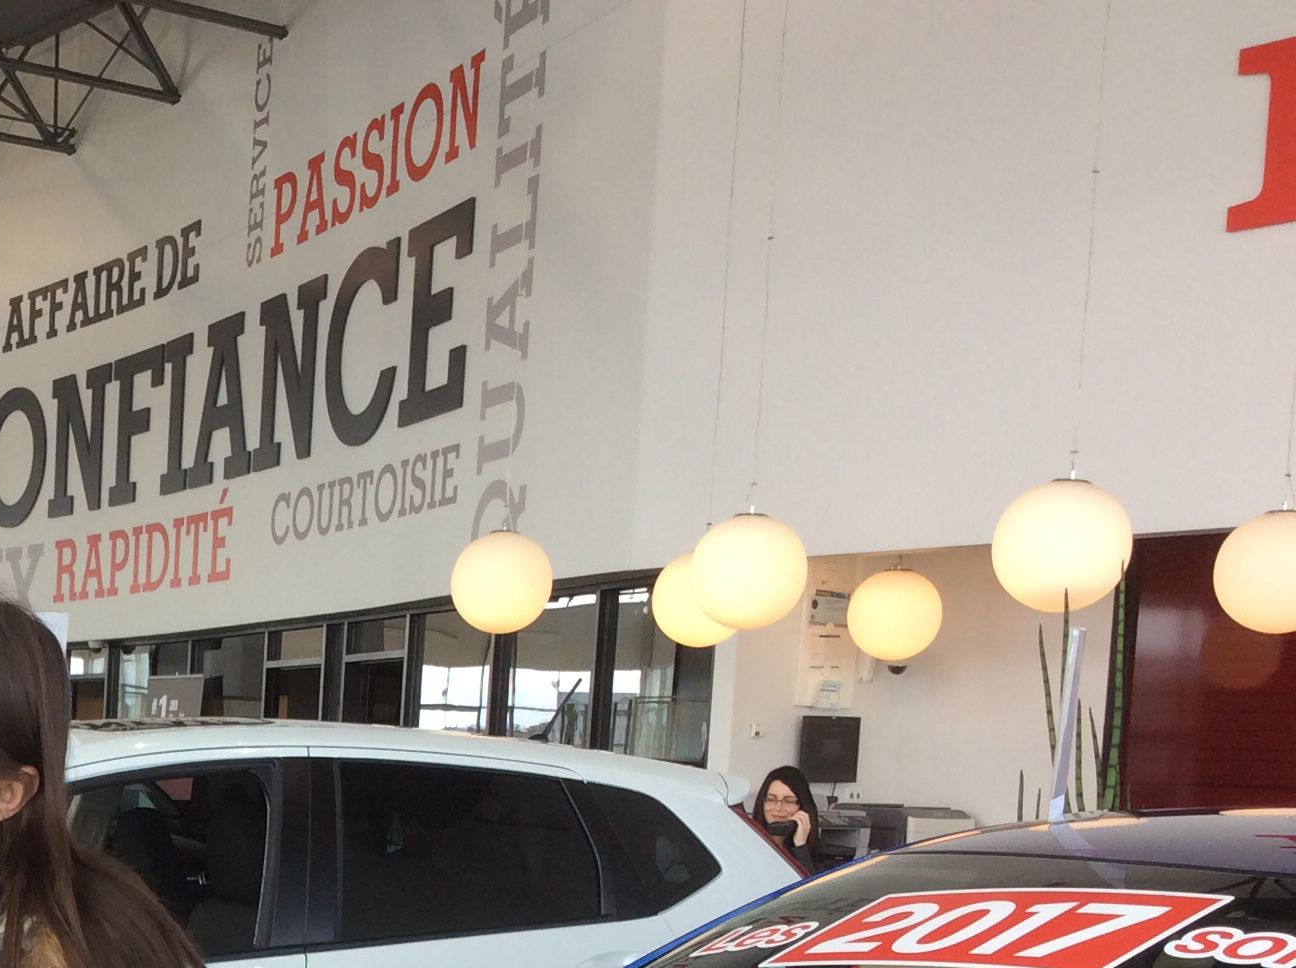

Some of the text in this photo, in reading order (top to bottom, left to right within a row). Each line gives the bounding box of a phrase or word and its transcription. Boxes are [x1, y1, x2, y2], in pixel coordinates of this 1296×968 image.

[246, 37, 273, 268] SERVICE
[270, 48, 486, 258] PASSION
[2, 245, 148, 353] AFFAIRE
[153, 219, 202, 301] DE
[52, 489, 233, 603] RAPIDITÉ
[270, 443, 460, 546] COURTOISIE
[804, 901, 1174, 960] 2017
